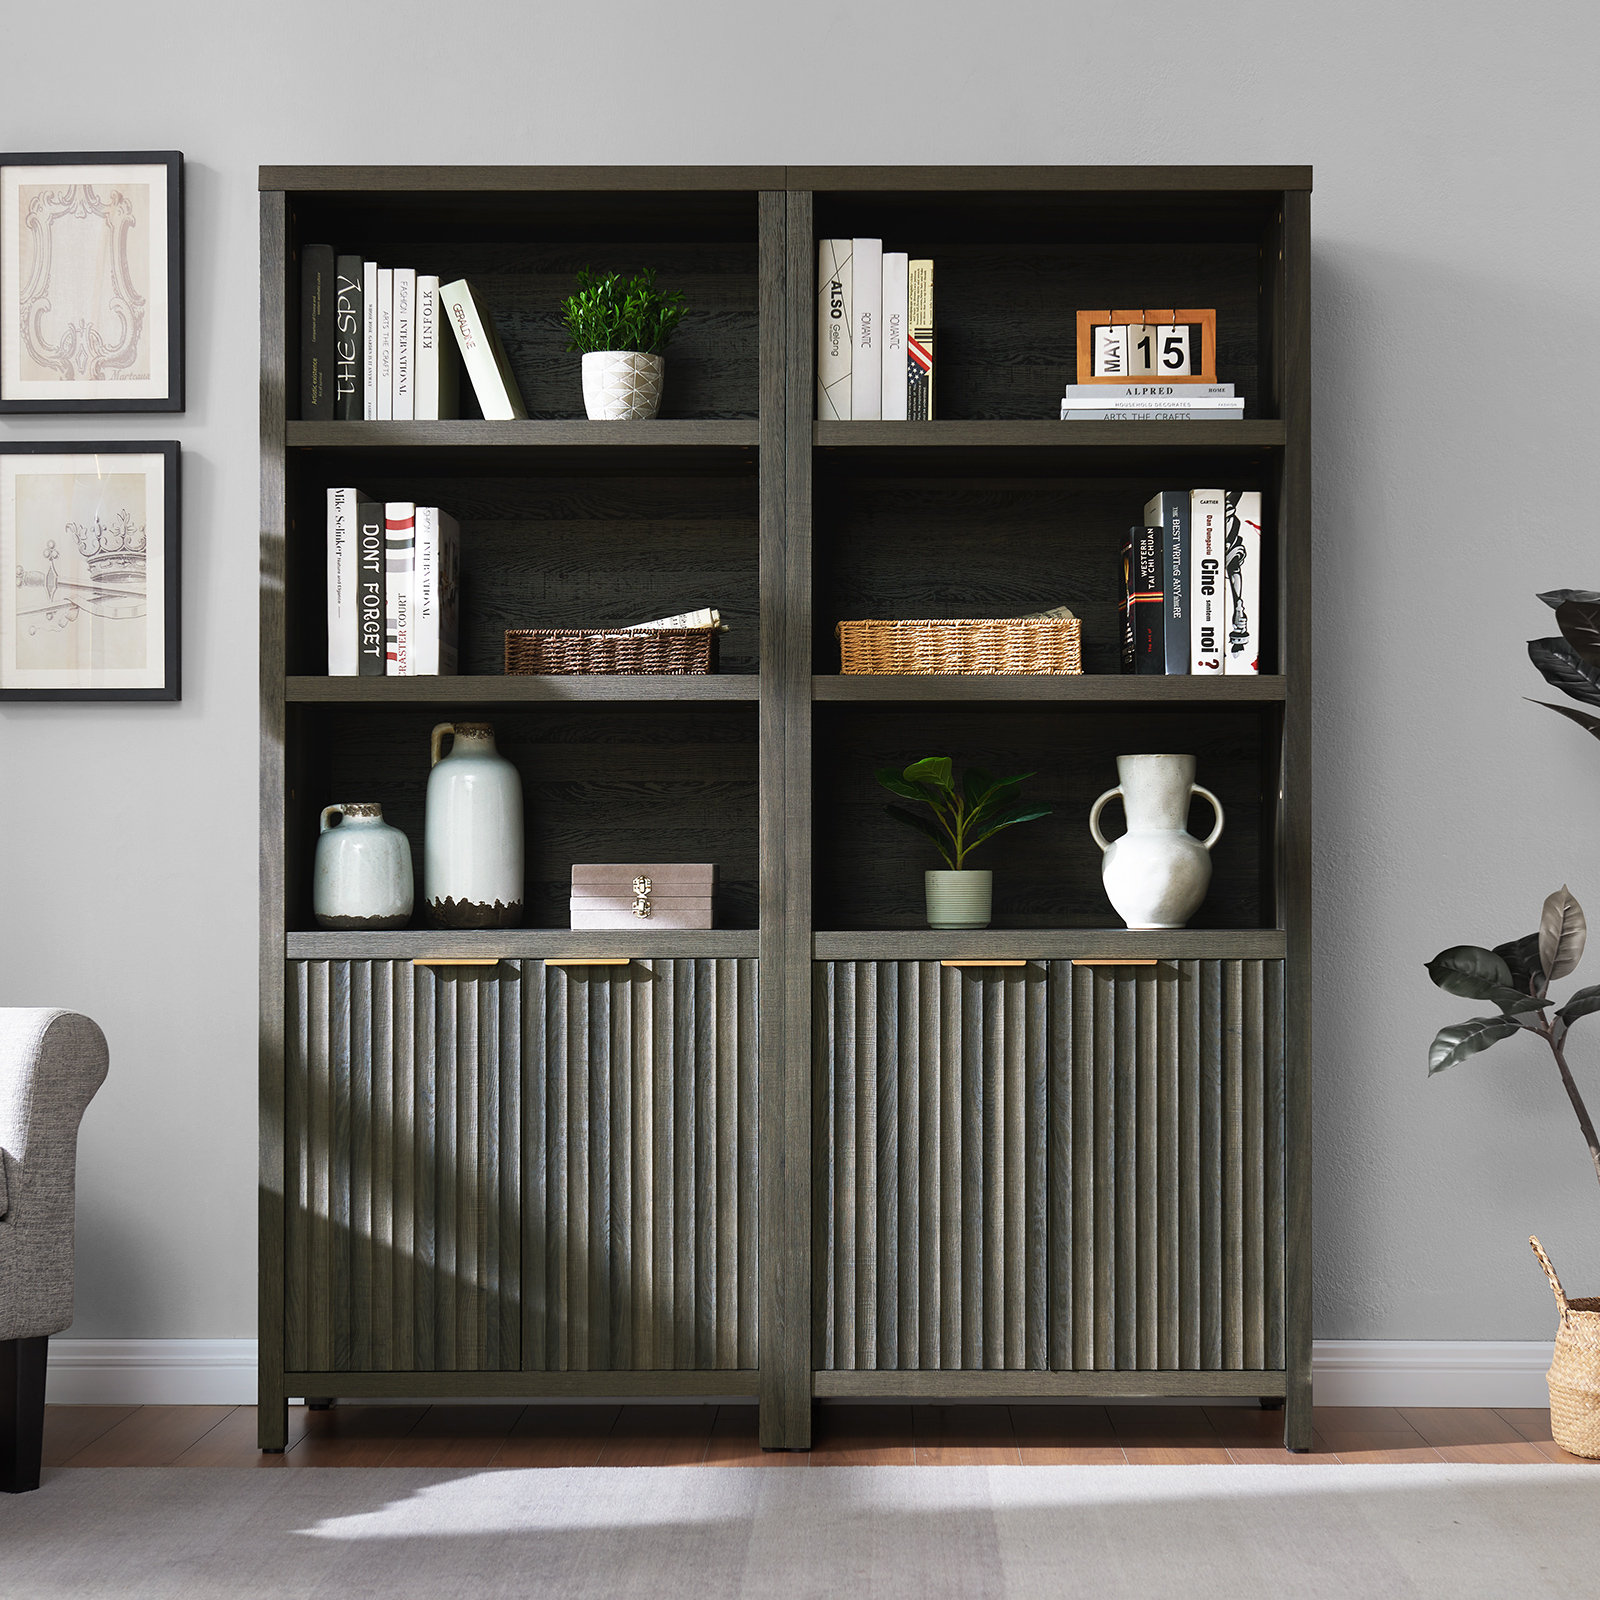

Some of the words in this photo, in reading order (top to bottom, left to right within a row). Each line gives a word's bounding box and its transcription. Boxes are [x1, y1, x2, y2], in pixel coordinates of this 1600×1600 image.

[337, 275, 362, 335] SPY
[400, 280, 408, 314] FASHION
[830, 280, 843, 319] ALSO
[423, 290, 433, 349] KINFOLK
[452, 302, 476, 350] GERALDINE
[861, 312, 871, 348] ROMANTIC
[890, 313, 900, 349] ROMANTIC
[399, 319, 408, 396] INTERNATIONAL
[831, 324, 841, 357] Gelang
[1104, 337, 1120, 372] MAY
[337, 339, 357, 401] THE
[1125, 387, 1173, 396] ALPRED
[1103, 413, 1127, 421] ARTS
[1131, 413, 1150, 421] THE
[1154, 413, 1191, 421] CRAFTS
[334, 489, 345, 513] Mike
[334, 515, 346, 557] Selinker
[1172, 519, 1180, 541] BEST
[362, 523, 380, 574] DONT
[1140, 539, 1148, 578] WESTERN
[1147, 575, 1155, 589] TAI
[1201, 558, 1219, 596] Cine
[362, 582, 381, 658] FORGET
[398, 593, 407, 627] COURT
[1201, 626, 1218, 653] noi
